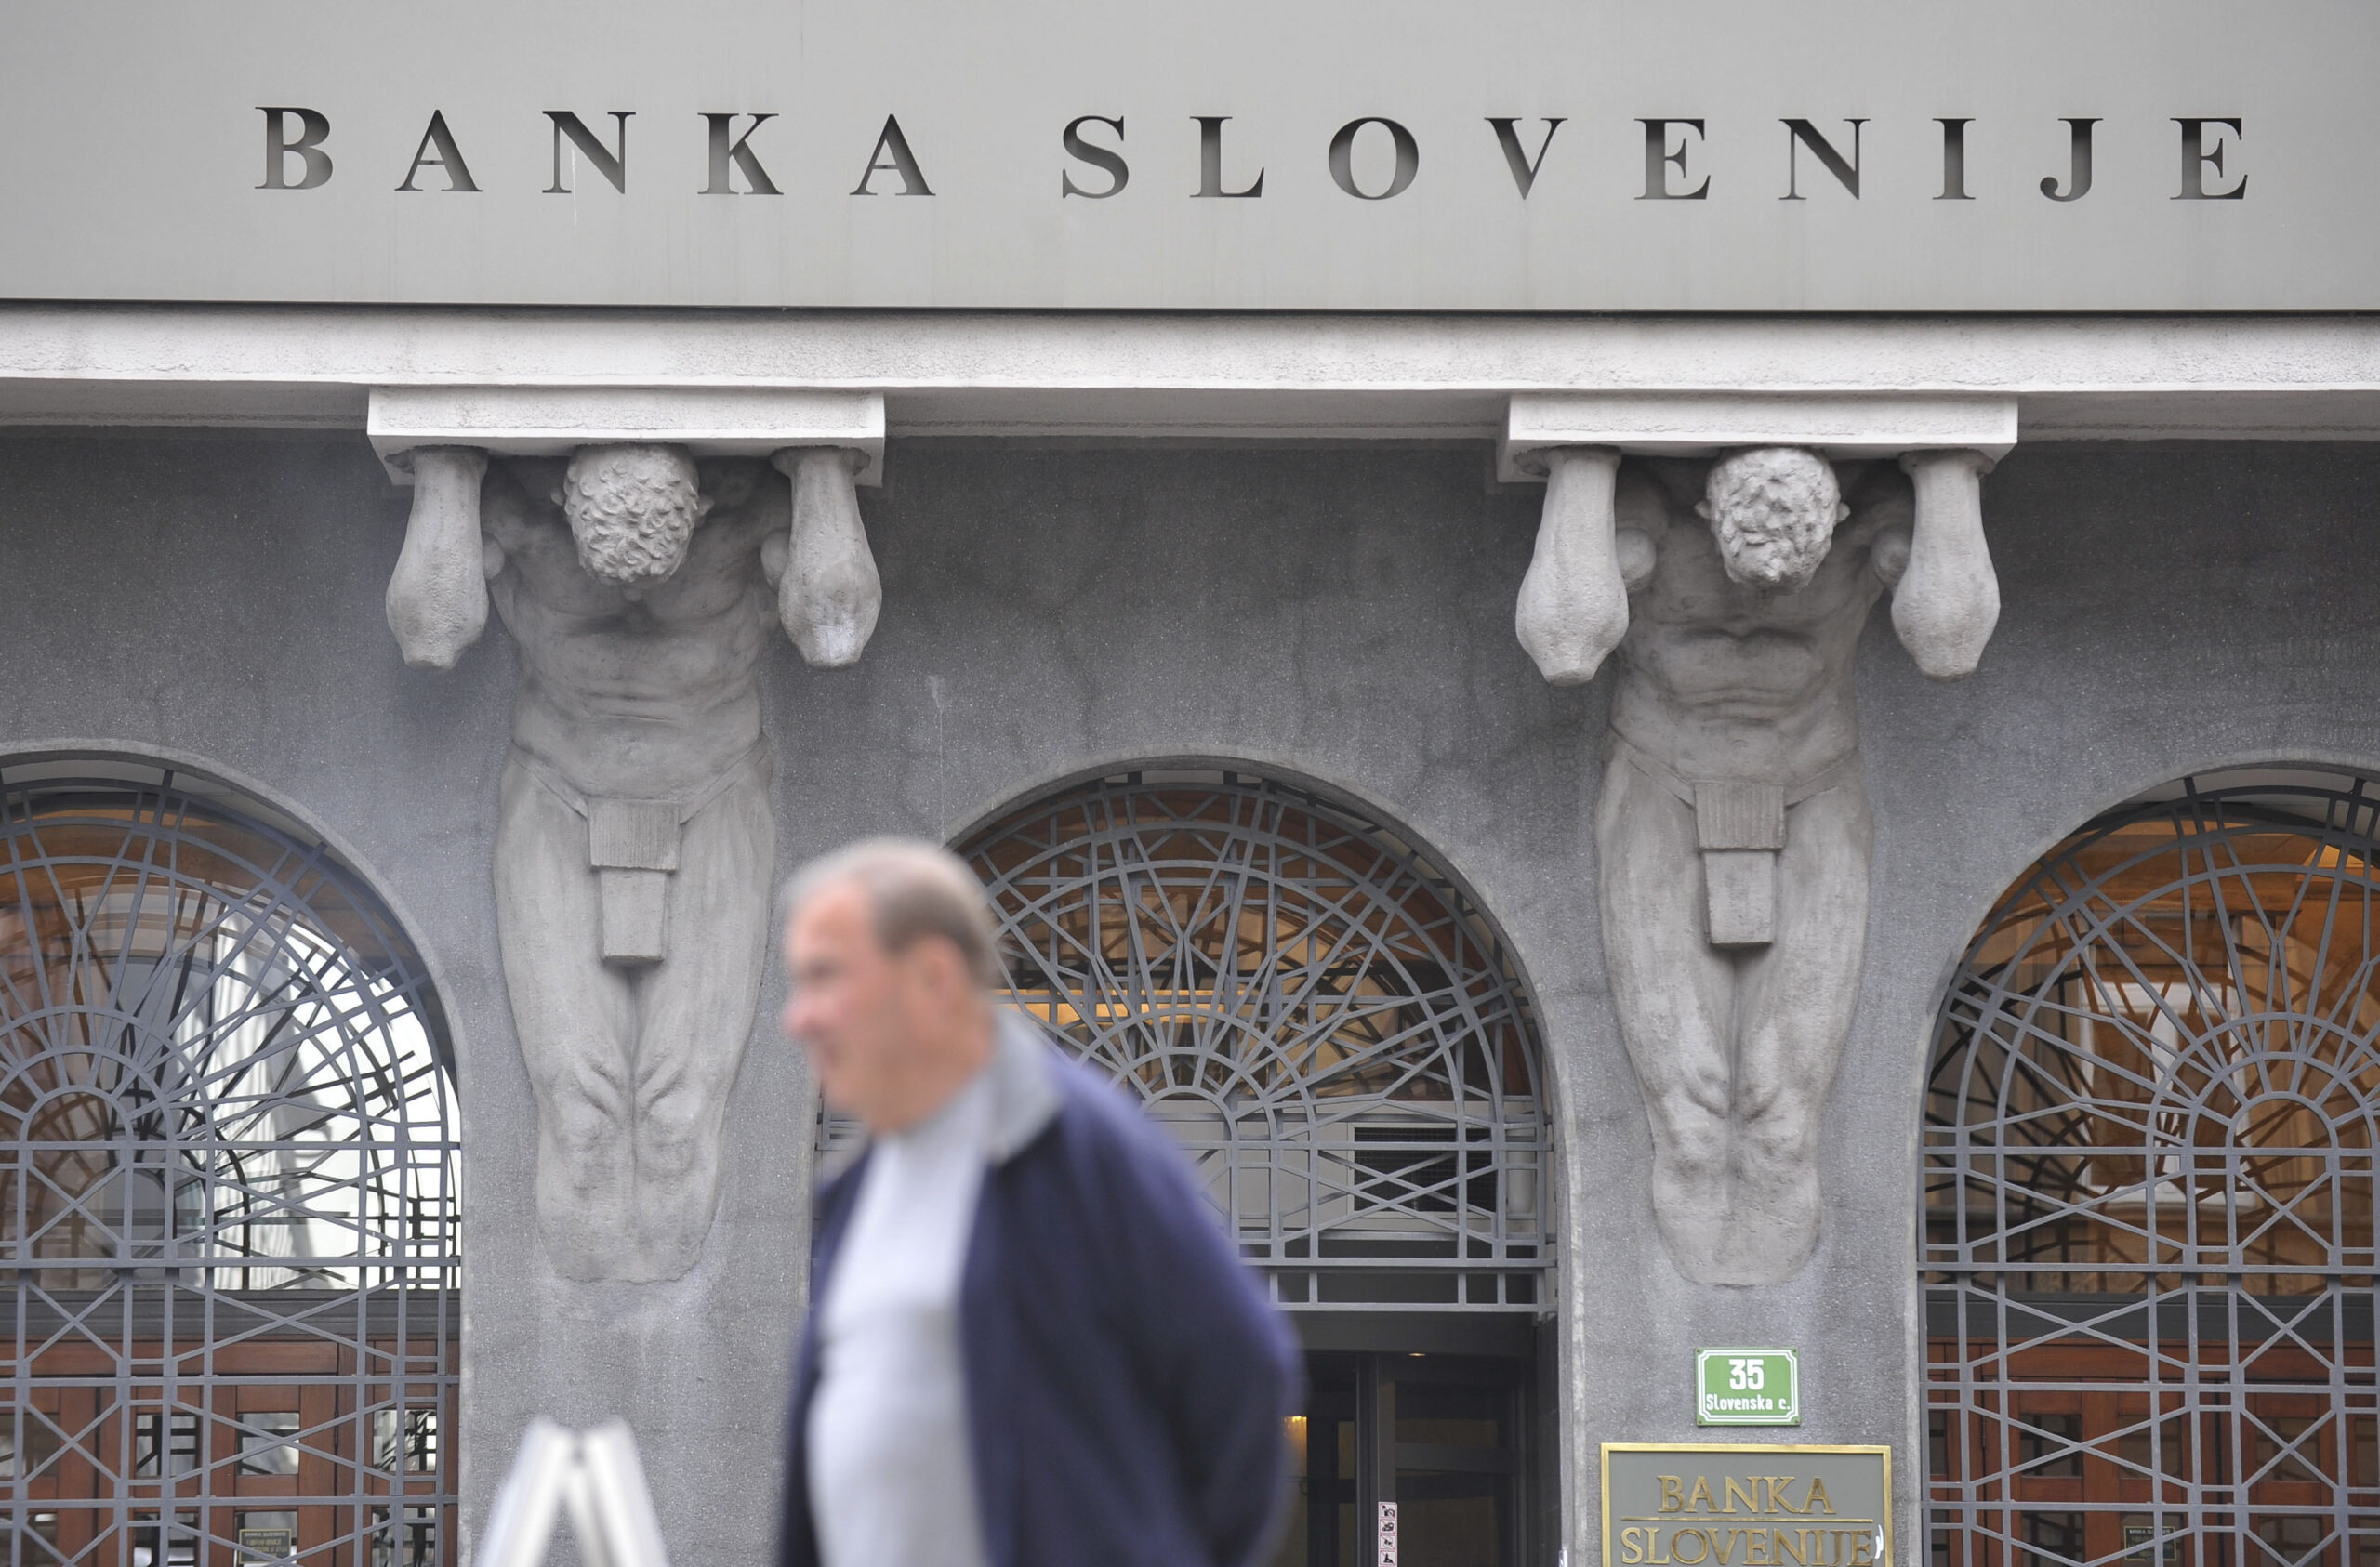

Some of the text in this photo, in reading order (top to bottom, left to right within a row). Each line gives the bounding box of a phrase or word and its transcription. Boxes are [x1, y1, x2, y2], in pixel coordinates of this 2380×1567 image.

[255, 106, 2248, 202] BANKA SLOVENIJE
[1729, 1359, 1764, 1390] 35
[1706, 1393, 1791, 1411] Slovenska c.
[1657, 1475, 1837, 1514] BANKA
[1620, 1527, 1873, 1567] SLOVENIJE
